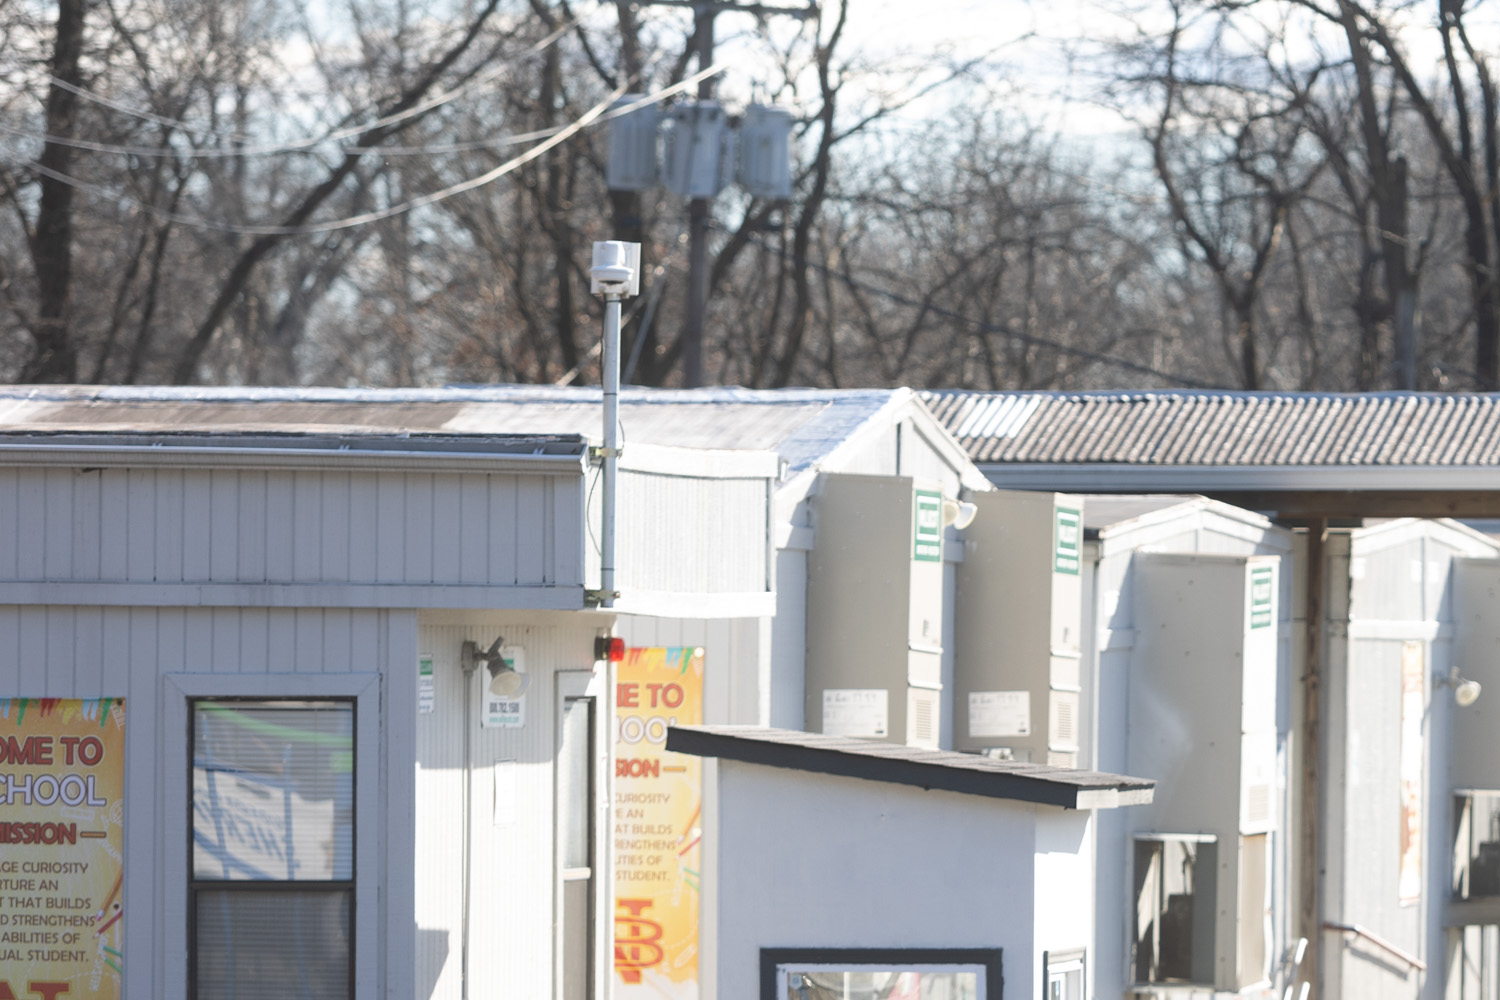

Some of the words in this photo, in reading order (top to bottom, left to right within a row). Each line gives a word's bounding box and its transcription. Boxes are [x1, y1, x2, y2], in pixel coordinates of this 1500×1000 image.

[646, 683, 684, 708] TO
[616, 715, 677, 745] OO
[60, 736, 104, 766] TO
[0, 773, 107, 807] HOOL
[626, 808, 644, 819] AN
[0, 822, 77, 845] ISSION
[631, 824, 673, 835] BUILDS
[646, 854, 663, 865] OF
[0, 861, 19, 873] GE
[22, 861, 89, 874] CURIOSITY
[0, 879, 36, 891] TURE
[39, 879, 59, 891] AN
[8, 896, 42, 908] THAT
[45, 897, 92, 910] BUILDS
[12, 914, 95, 927] STRENGTHENS
[2, 931, 59, 944] ABILITIES
[62, 932, 81, 944] OF
[27, 949, 89, 962] STUDENT.
